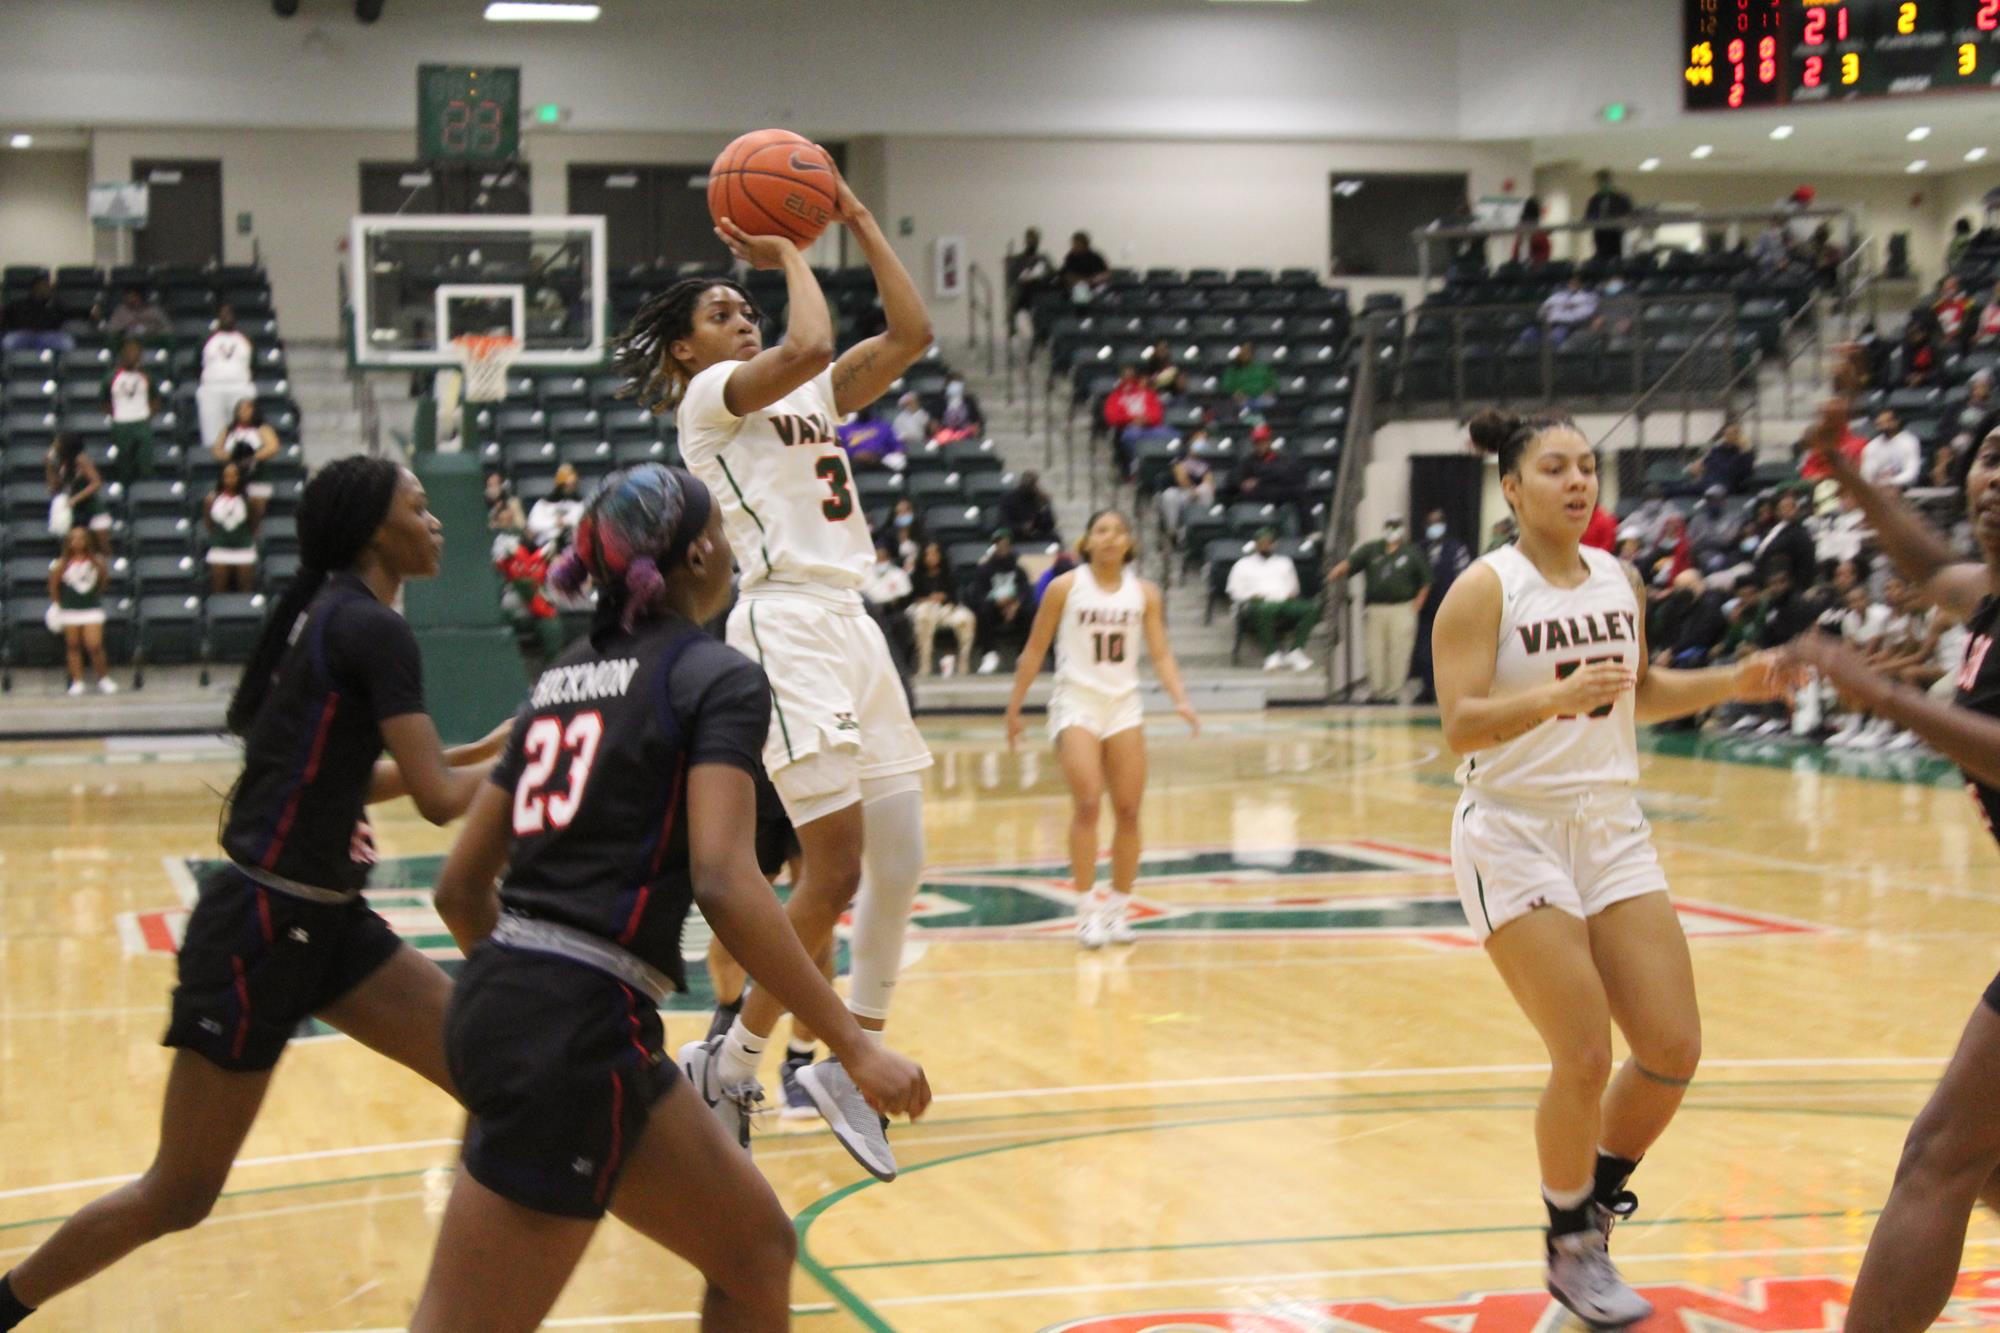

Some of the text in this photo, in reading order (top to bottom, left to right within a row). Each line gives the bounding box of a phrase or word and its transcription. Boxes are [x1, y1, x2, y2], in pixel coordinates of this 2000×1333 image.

[1804, 6, 1849, 46] 21
[1897, 2, 1918, 35] 2
[1728, 38, 1745, 64] 0
[1759, 35, 1776, 60] 0
[1958, 42, 1977, 76] 3
[1803, 55, 1823, 88] 2
[1841, 52, 1860, 85] 3
[443, 99, 503, 149] 23
[815, 455, 853, 522] 3
[1091, 630, 1125, 665] 10
[1516, 610, 1635, 656] VALLEY
[513, 709, 605, 836] 23
